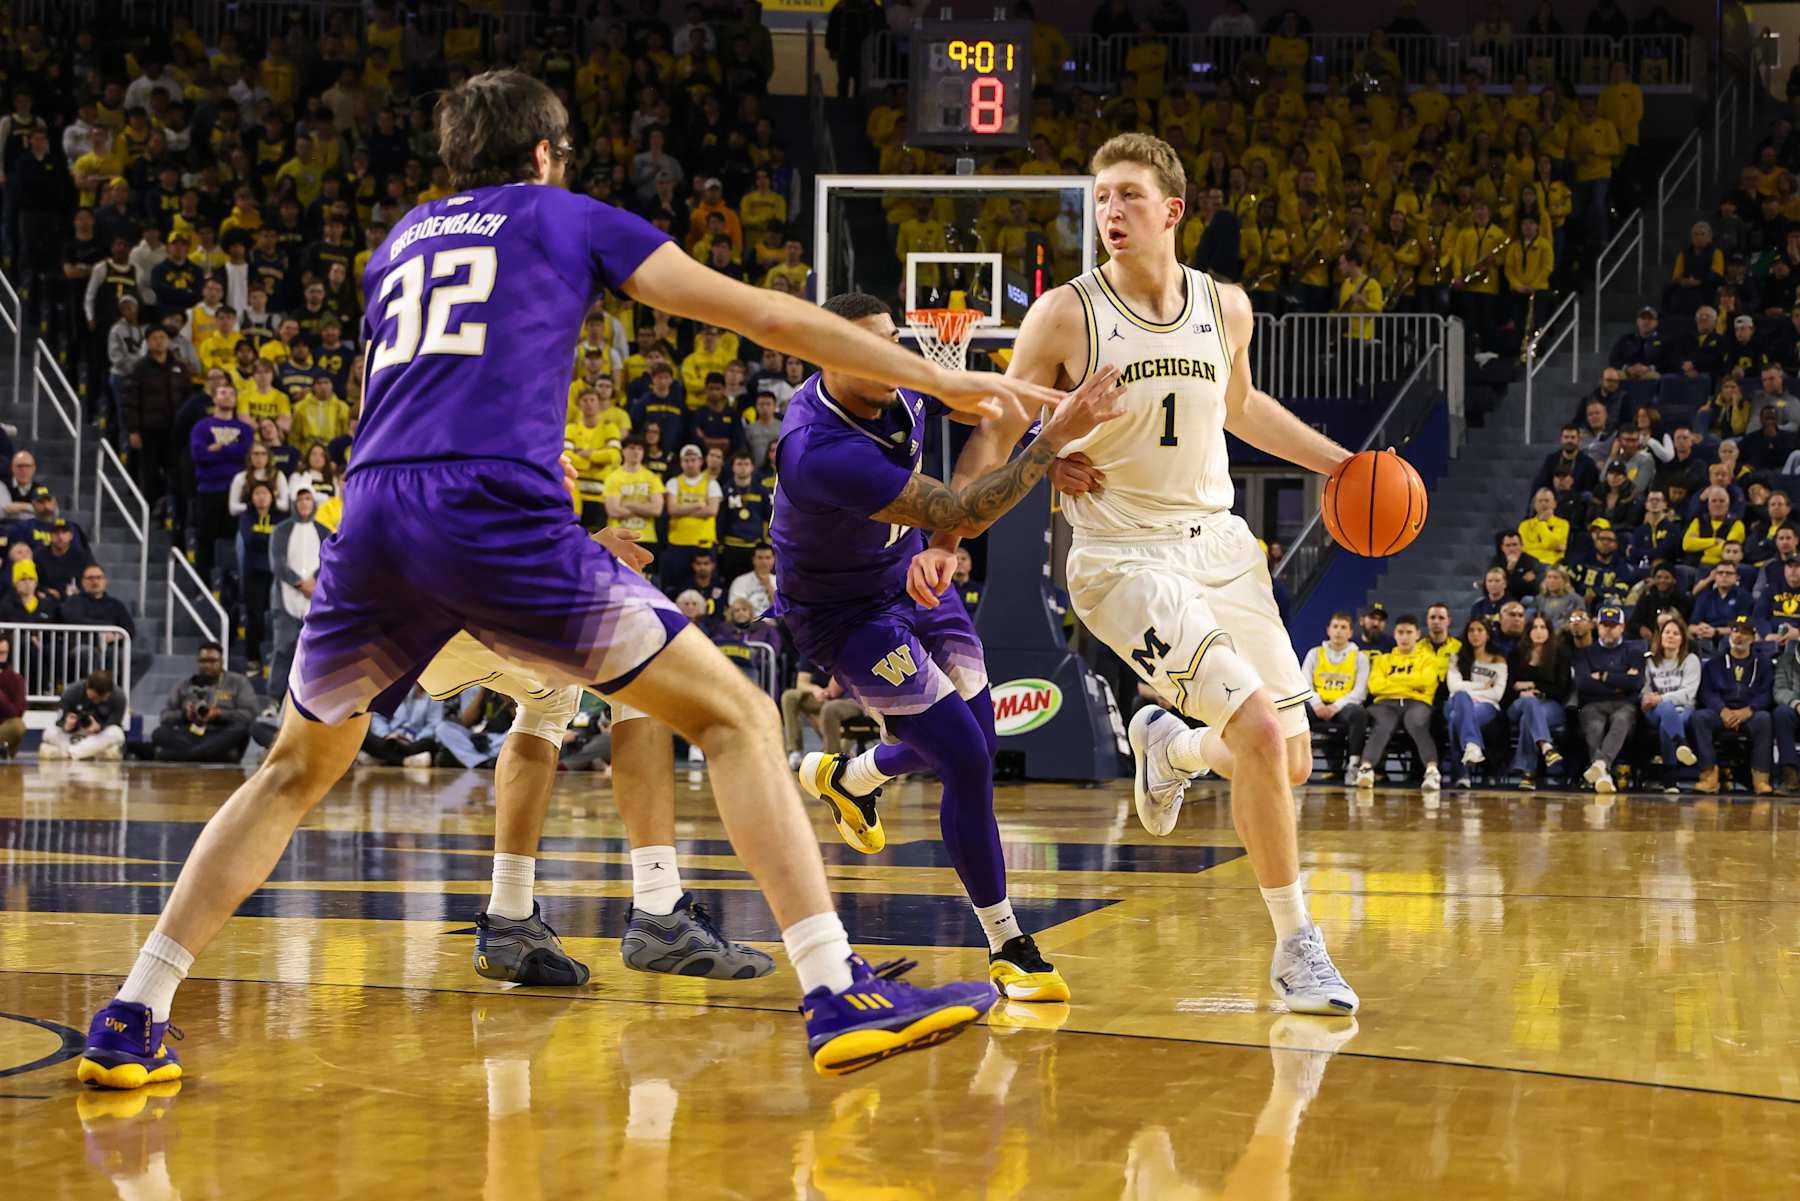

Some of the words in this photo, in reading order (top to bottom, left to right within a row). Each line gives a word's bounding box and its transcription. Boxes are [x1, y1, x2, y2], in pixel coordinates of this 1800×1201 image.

[948, 40, 1014, 73] 9:01
[970, 77, 1004, 133] 8
[390, 212, 507, 262] BREIDENBACH
[370, 246, 498, 378] 32
[1115, 358, 1217, 388] MICHIGAN
[1160, 393, 1178, 447] 1
[1190, 525, 1201, 538] M
[871, 644, 919, 688] W
[1131, 626, 1172, 677] M
[991, 688, 1051, 721] MAN
[105, 1017, 128, 1034] UW
